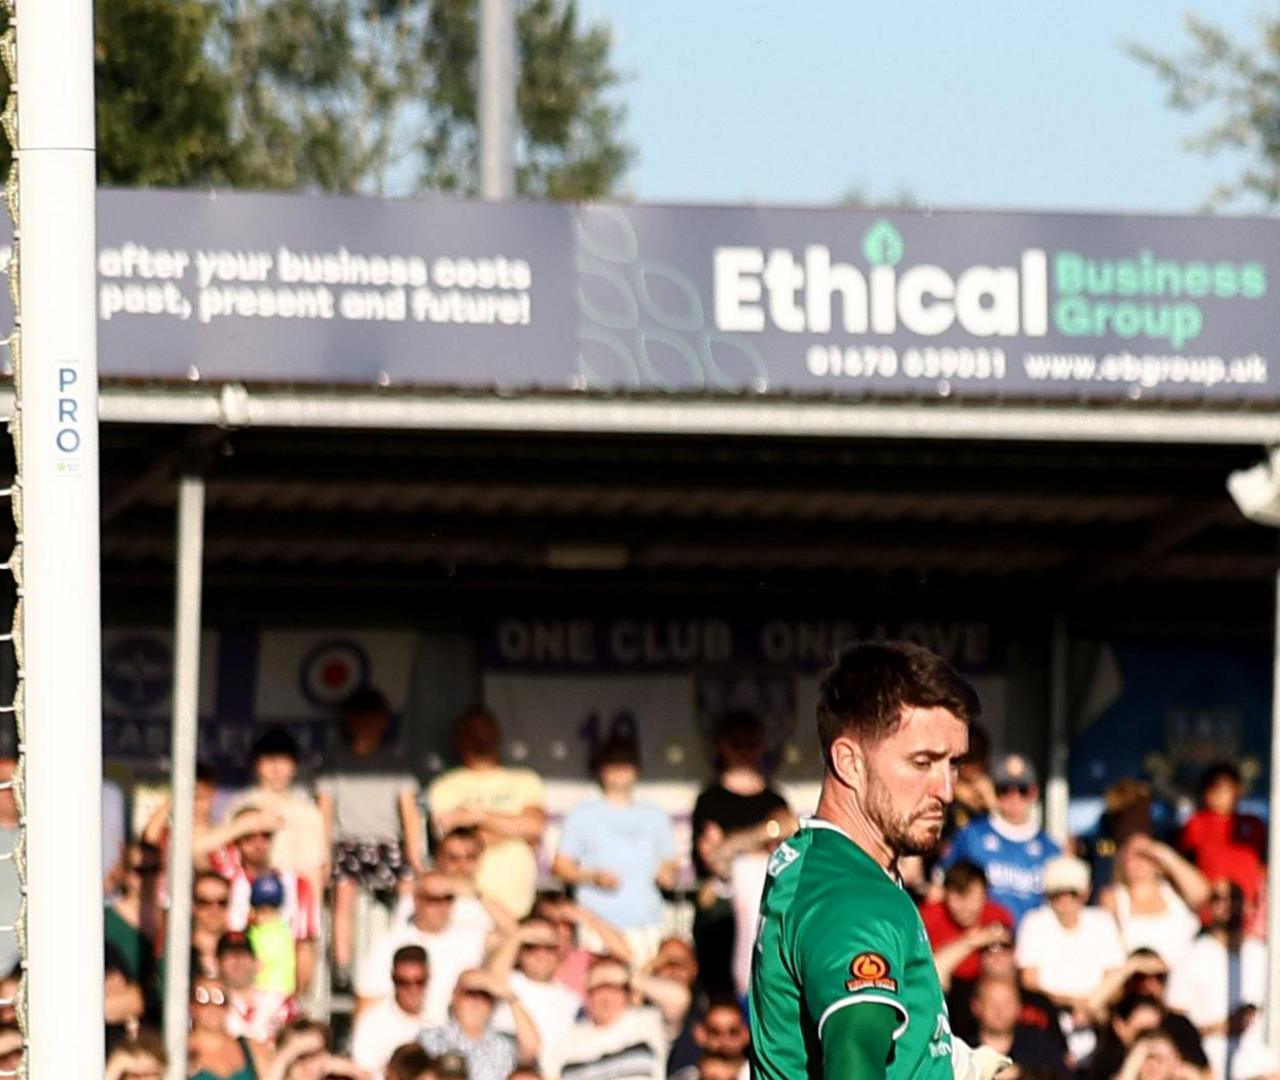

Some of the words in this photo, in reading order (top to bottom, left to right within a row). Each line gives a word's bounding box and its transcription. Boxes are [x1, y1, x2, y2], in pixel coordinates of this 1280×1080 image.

[99, 242, 189, 279] after
[196, 250, 272, 288] your
[278, 245, 427, 287] business
[432, 255, 531, 290] costs
[714, 243, 1048, 336] Ethical
[1055, 250, 1266, 298] Business
[100, 282, 192, 320] past,
[199, 284, 335, 323] present
[340, 287, 407, 321] and
[411, 287, 531, 326] future!
[1055, 299, 1201, 349] Group
[56, 368, 81, 453] PRO
